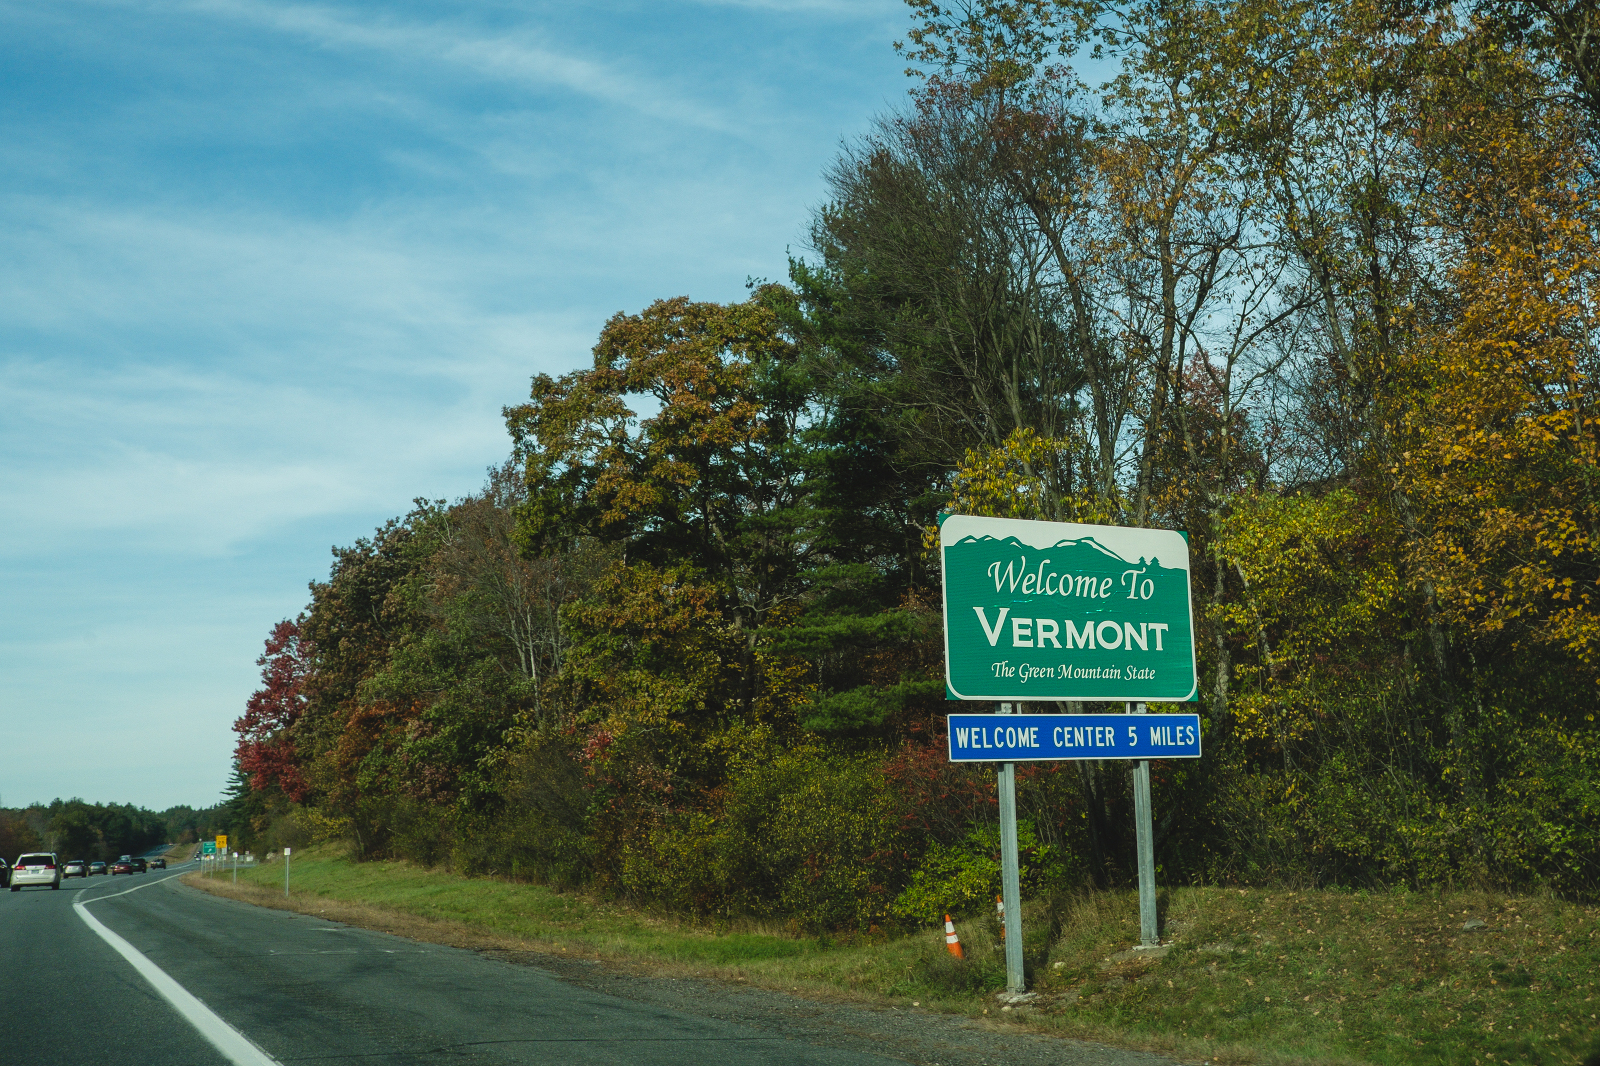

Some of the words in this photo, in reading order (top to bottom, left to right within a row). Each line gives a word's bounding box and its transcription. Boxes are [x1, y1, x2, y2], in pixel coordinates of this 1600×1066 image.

[987, 556, 1113, 599] Welcome
[1121, 567, 1155, 600] To
[973, 606, 1169, 651] VERMONT
[991, 660, 1015, 678] The
[1018, 663, 1055, 684] Green
[1058, 664, 1121, 680] Mountain
[1124, 665, 1156, 681] State
[955, 727, 1040, 749] WELCOME
[1053, 727, 1115, 748] CENTER
[1128, 726, 1138, 747] 5
[1150, 726, 1195, 746] MILES
